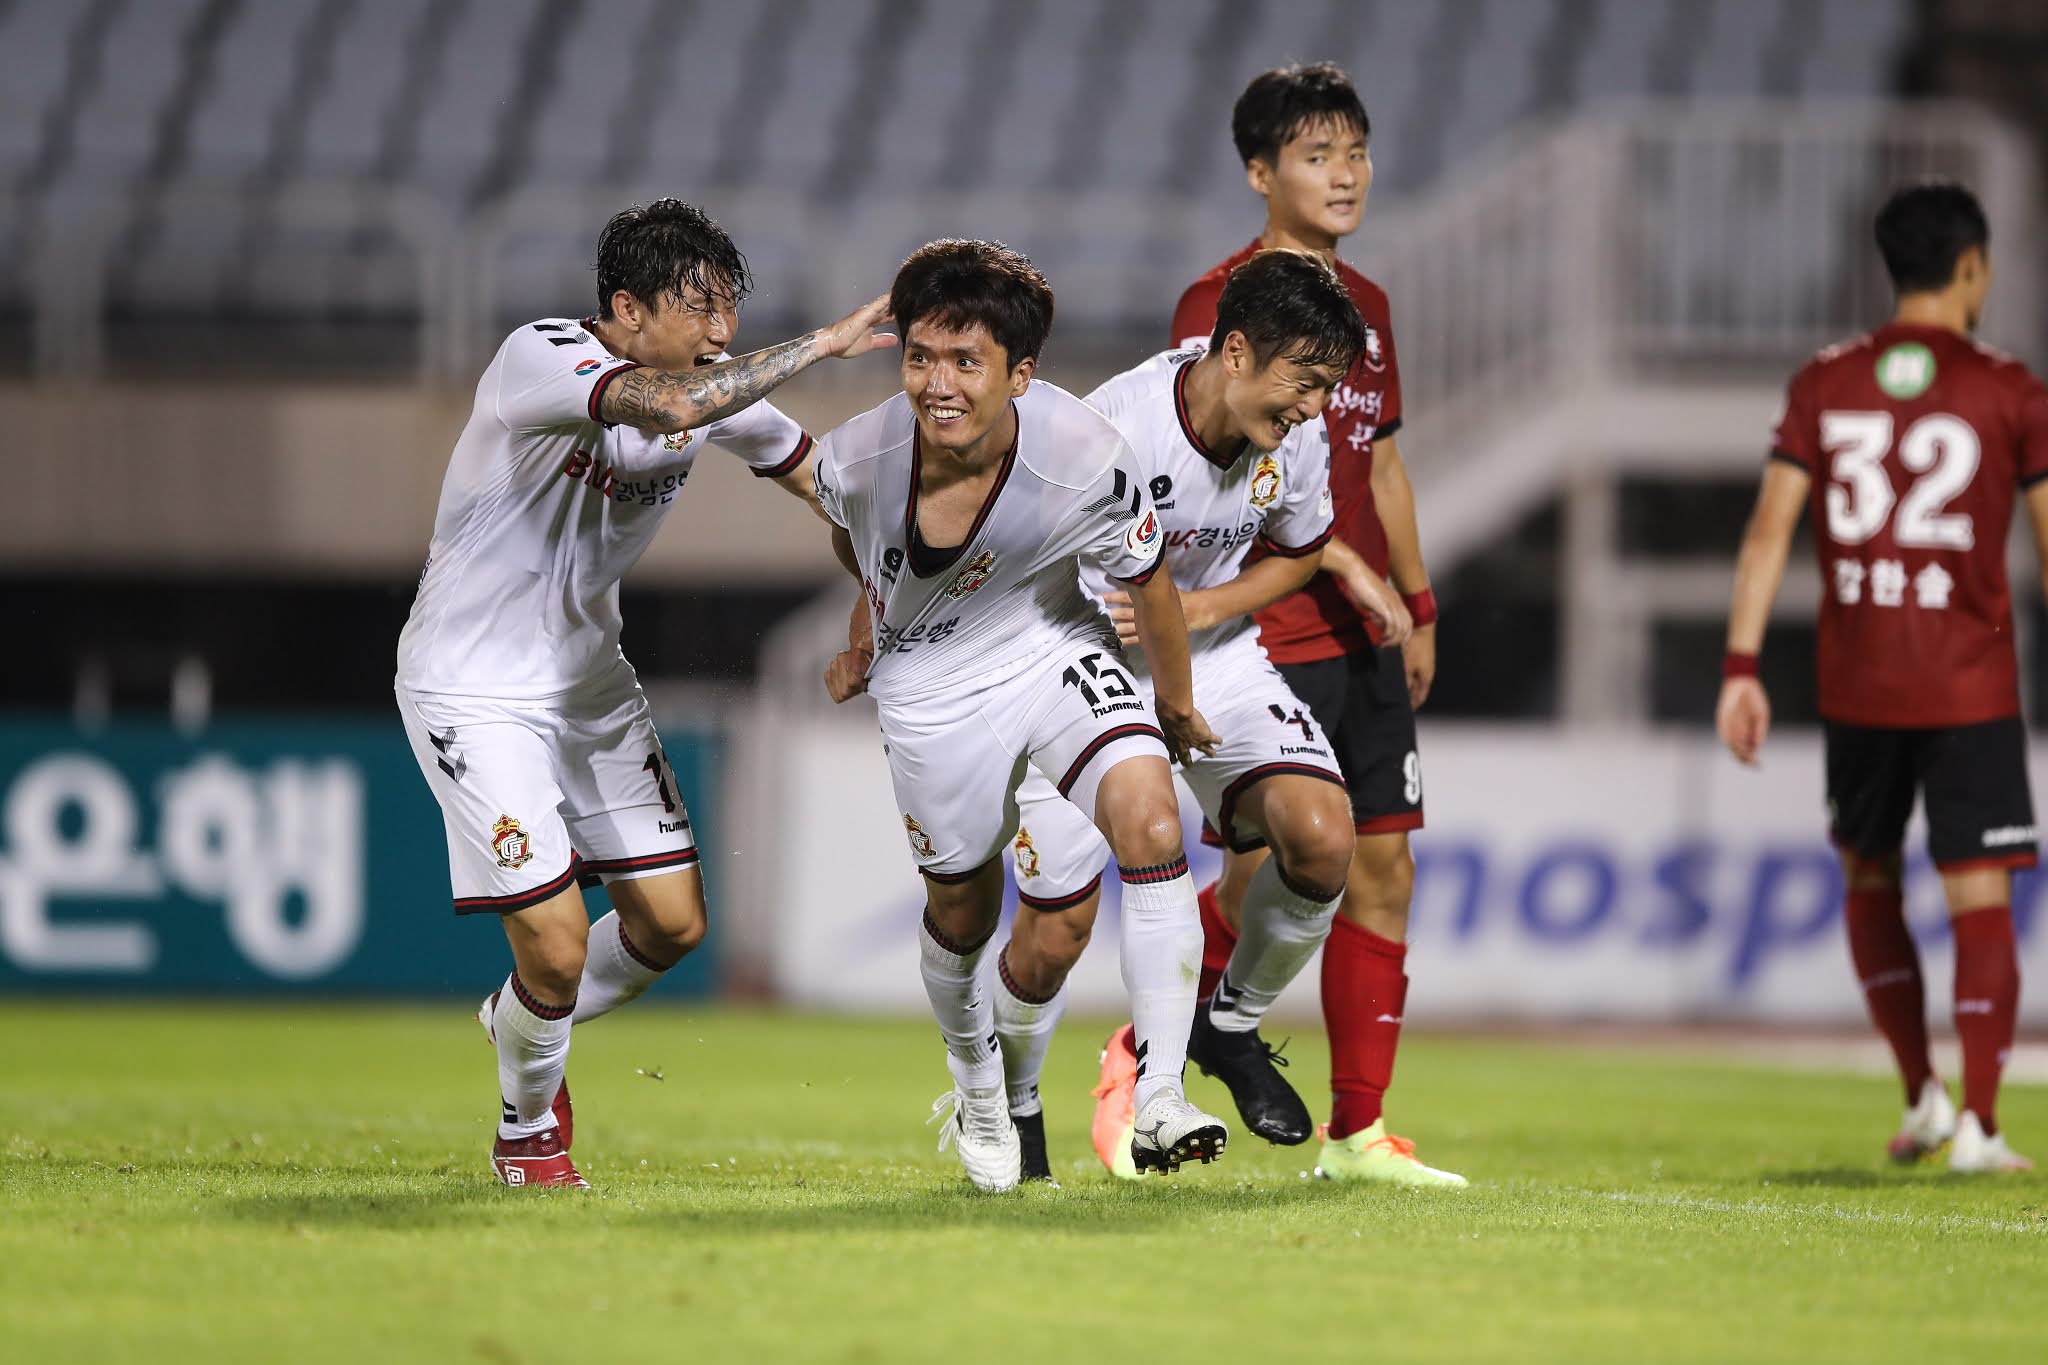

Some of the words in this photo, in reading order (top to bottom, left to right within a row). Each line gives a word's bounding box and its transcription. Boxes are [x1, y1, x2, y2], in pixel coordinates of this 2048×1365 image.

[1817, 408, 1983, 552] 32
[1062, 652, 1136, 708] 15
[1091, 701, 1144, 719] hummel
[1268, 703, 1315, 742] 4
[1280, 744, 1329, 759] hummel
[1403, 750, 1421, 806] 9
[0, 747, 365, 979] 은행
